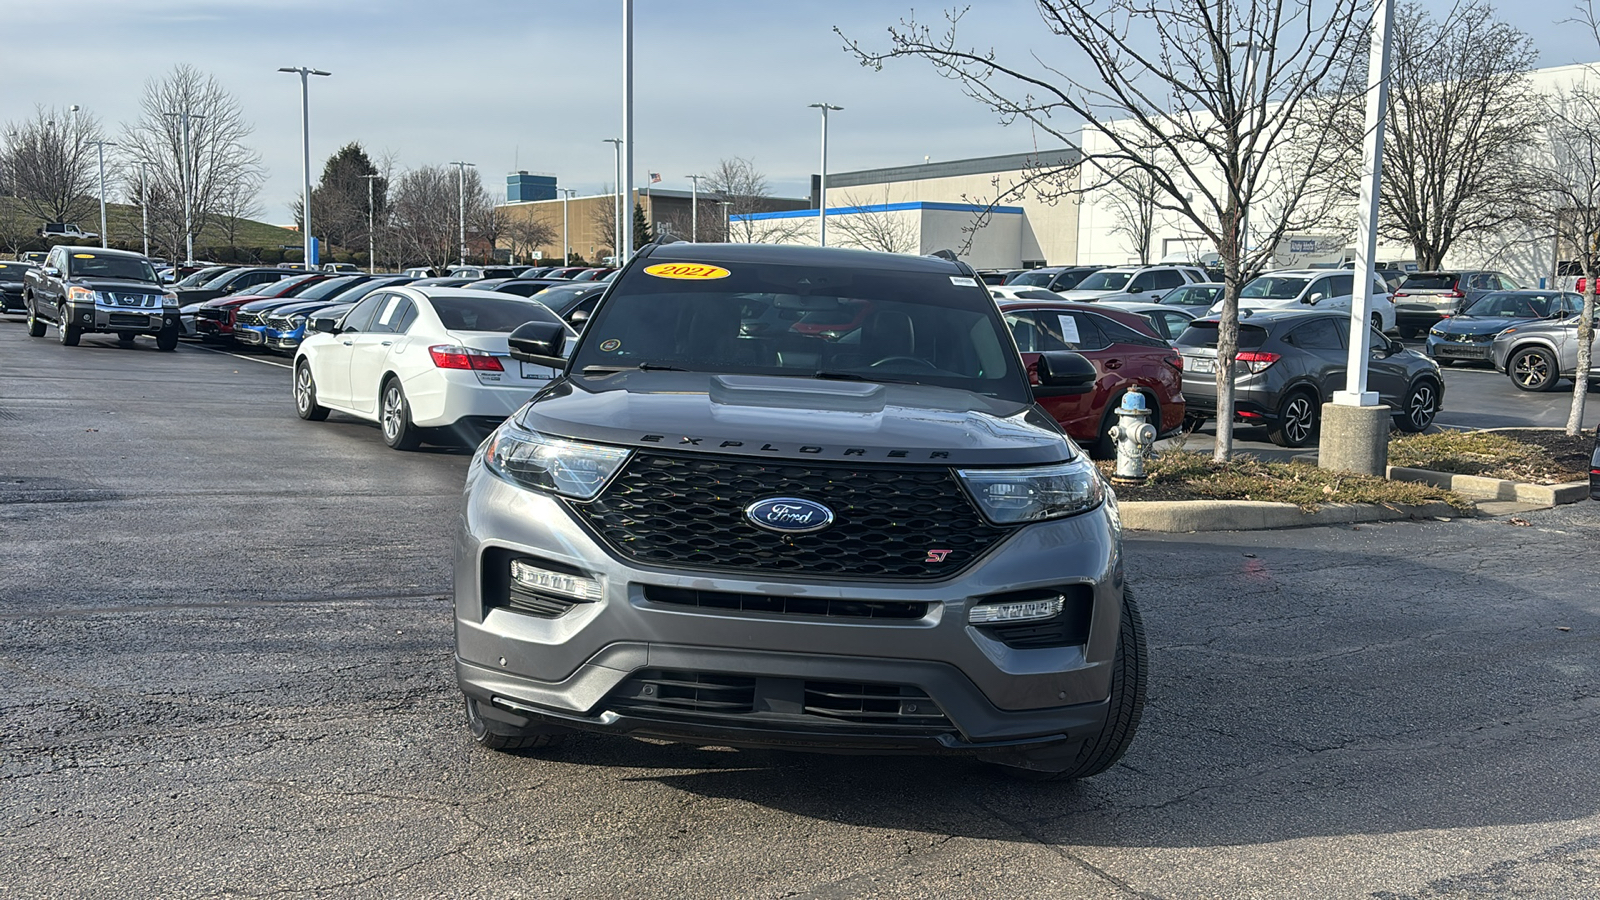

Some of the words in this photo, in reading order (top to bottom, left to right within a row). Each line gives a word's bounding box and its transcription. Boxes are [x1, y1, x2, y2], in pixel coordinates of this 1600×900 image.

[657, 266, 718, 277] 2021
[640, 434, 950, 459] EXPLORER
[766, 503, 813, 524] Ford
[925, 549, 953, 562] ST
